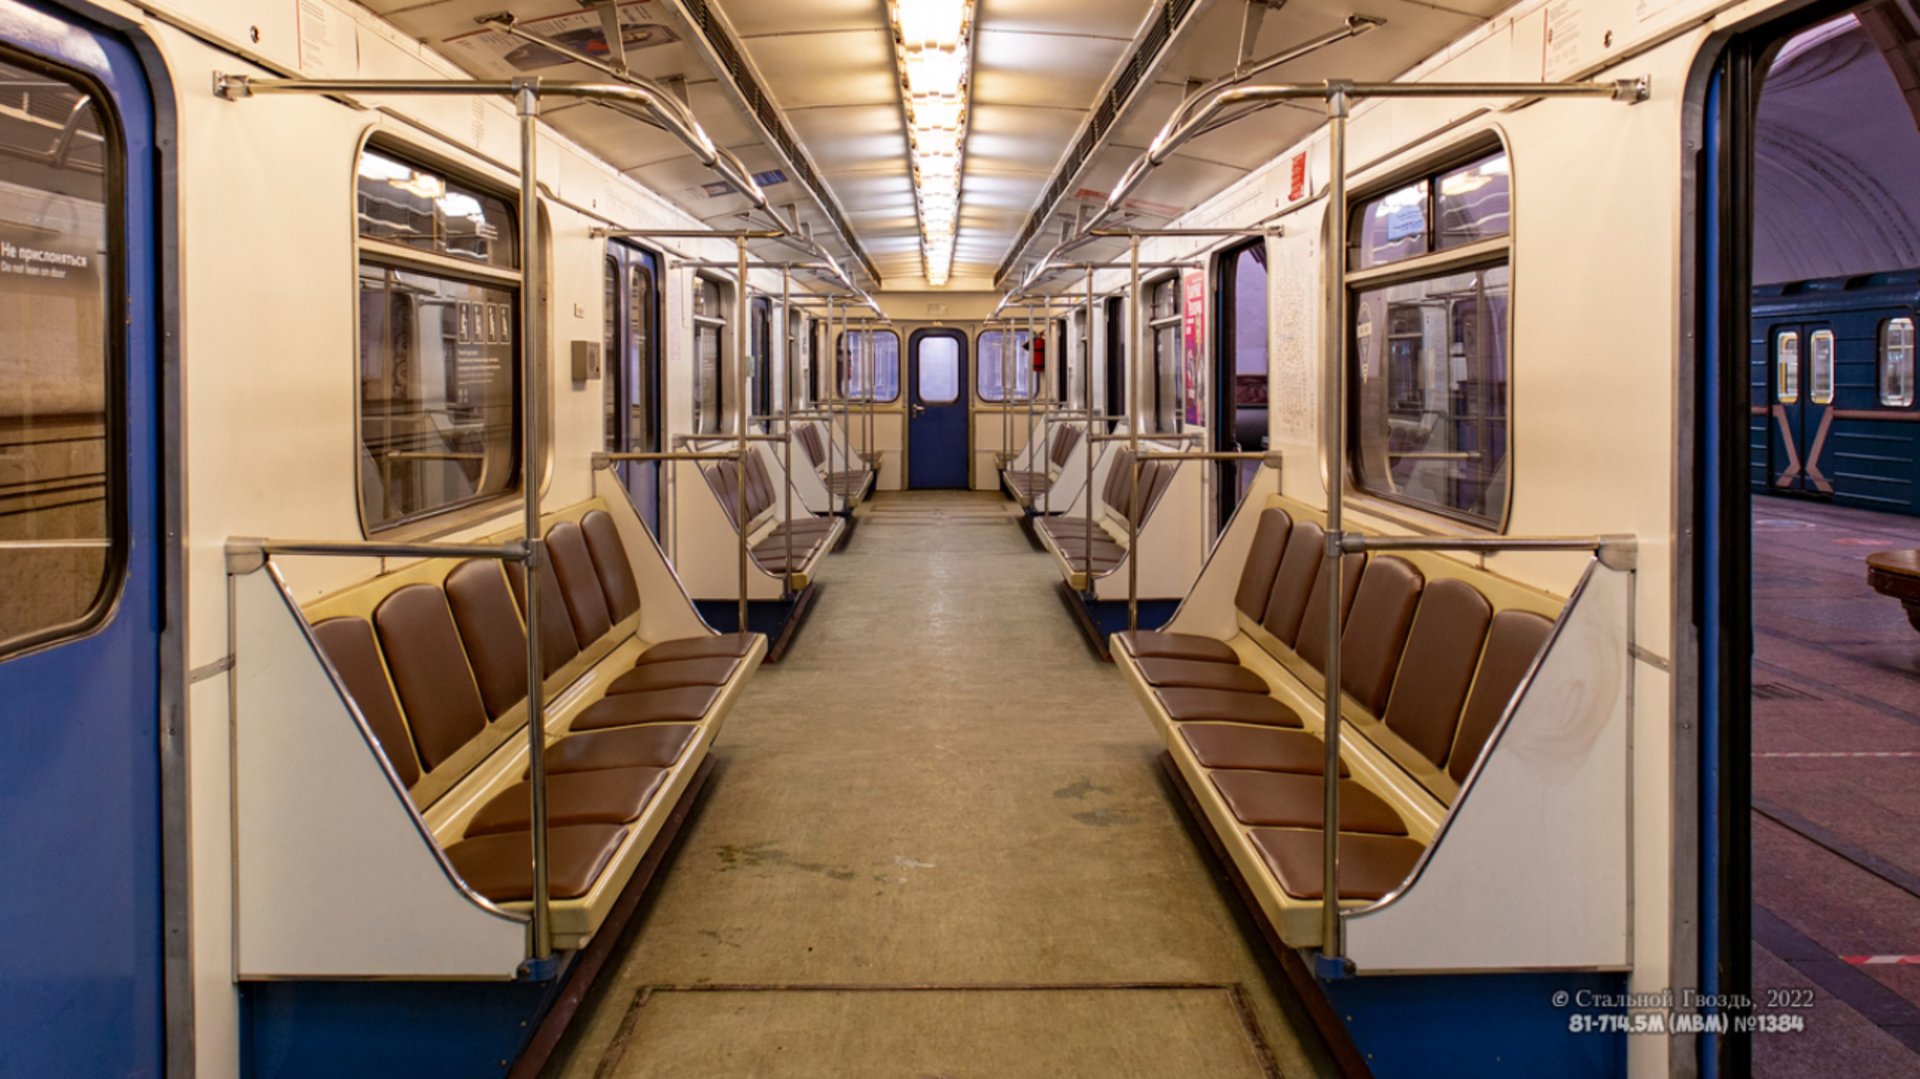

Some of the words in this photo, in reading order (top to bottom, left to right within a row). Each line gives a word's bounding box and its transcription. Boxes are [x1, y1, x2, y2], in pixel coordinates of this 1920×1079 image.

[1, 240, 17, 258] Не
[19, 247, 87, 267] прислоняться
[1, 260, 12, 272] Do
